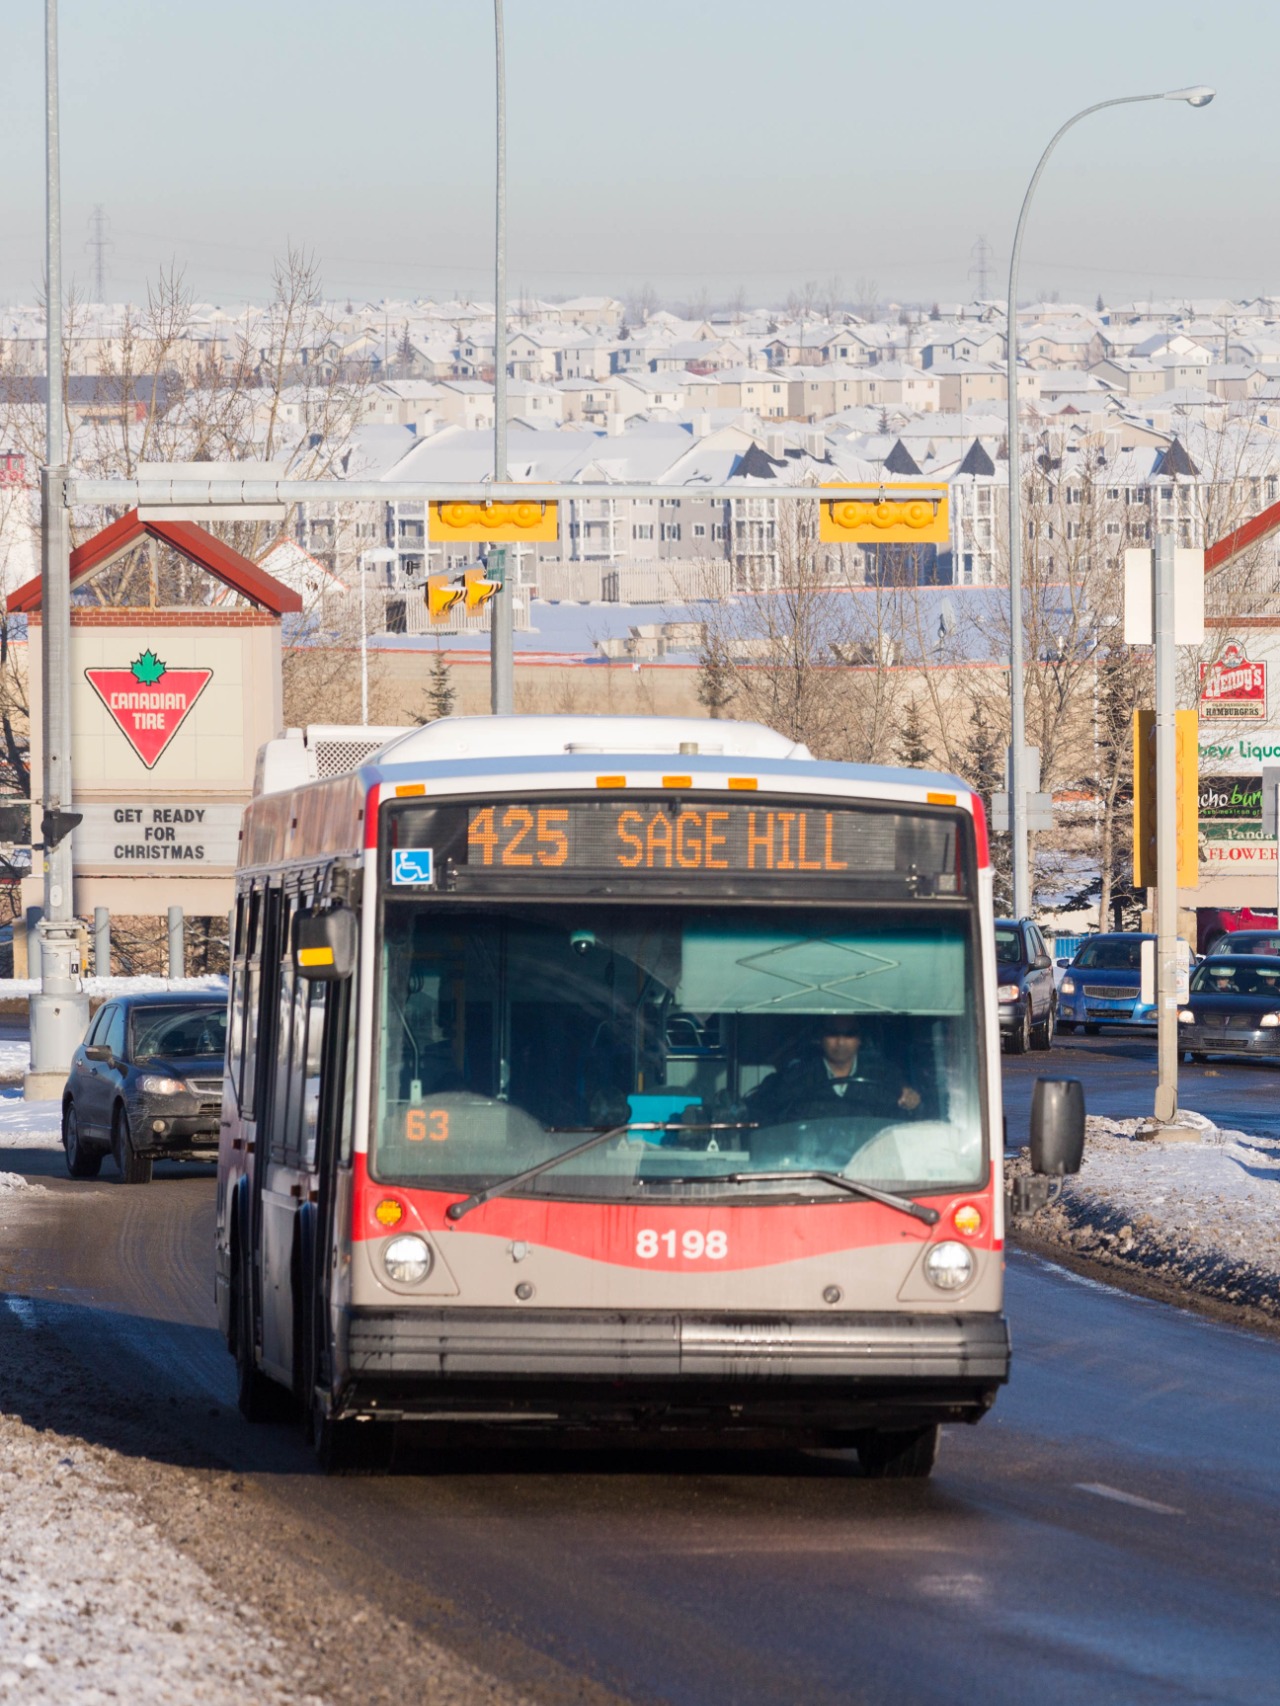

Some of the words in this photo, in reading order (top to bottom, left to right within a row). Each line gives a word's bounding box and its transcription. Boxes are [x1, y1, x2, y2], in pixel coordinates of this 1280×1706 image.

[110, 692, 187, 710] CANADIAN
[1205, 707, 1259, 716] HAMBURGERS
[132, 712, 165, 730] TIRE
[113, 809, 143, 823] GET
[153, 809, 206, 823] READY
[144, 827, 175, 841] FOR
[467, 808, 569, 867] 425
[616, 810, 730, 869] SAGE
[747, 811, 848, 871] HILL
[113, 845, 205, 860] CHRISTMAS
[406, 1108, 449, 1142] 63
[635, 1228, 729, 1260] 8198
